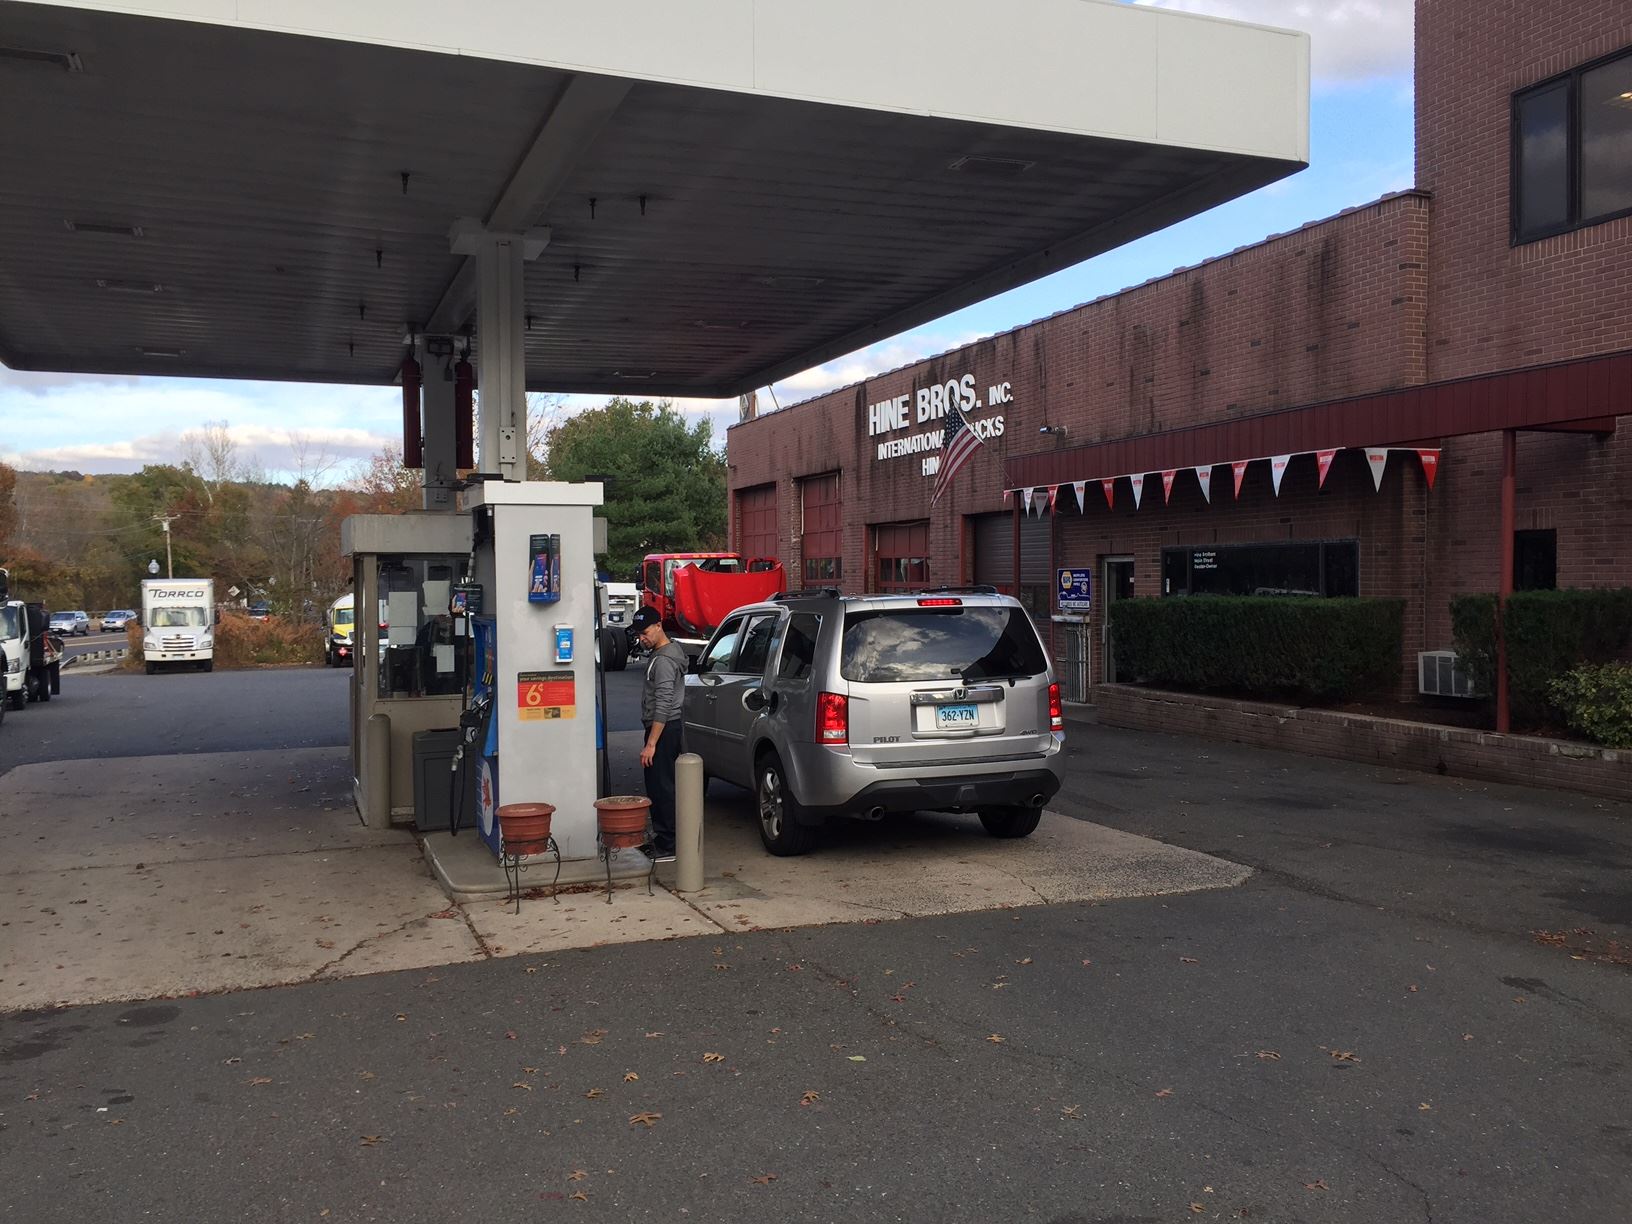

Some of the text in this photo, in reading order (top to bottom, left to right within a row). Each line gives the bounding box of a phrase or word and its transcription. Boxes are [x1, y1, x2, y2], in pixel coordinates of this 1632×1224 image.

[869, 373, 1014, 436] HINE BROS. INC.
[877, 415, 1005, 460] INTERNATIONA UCKS
[922, 456, 940, 476] HIN
[149, 588, 204, 598] TORRCO
[873, 735, 901, 744] PILOT
